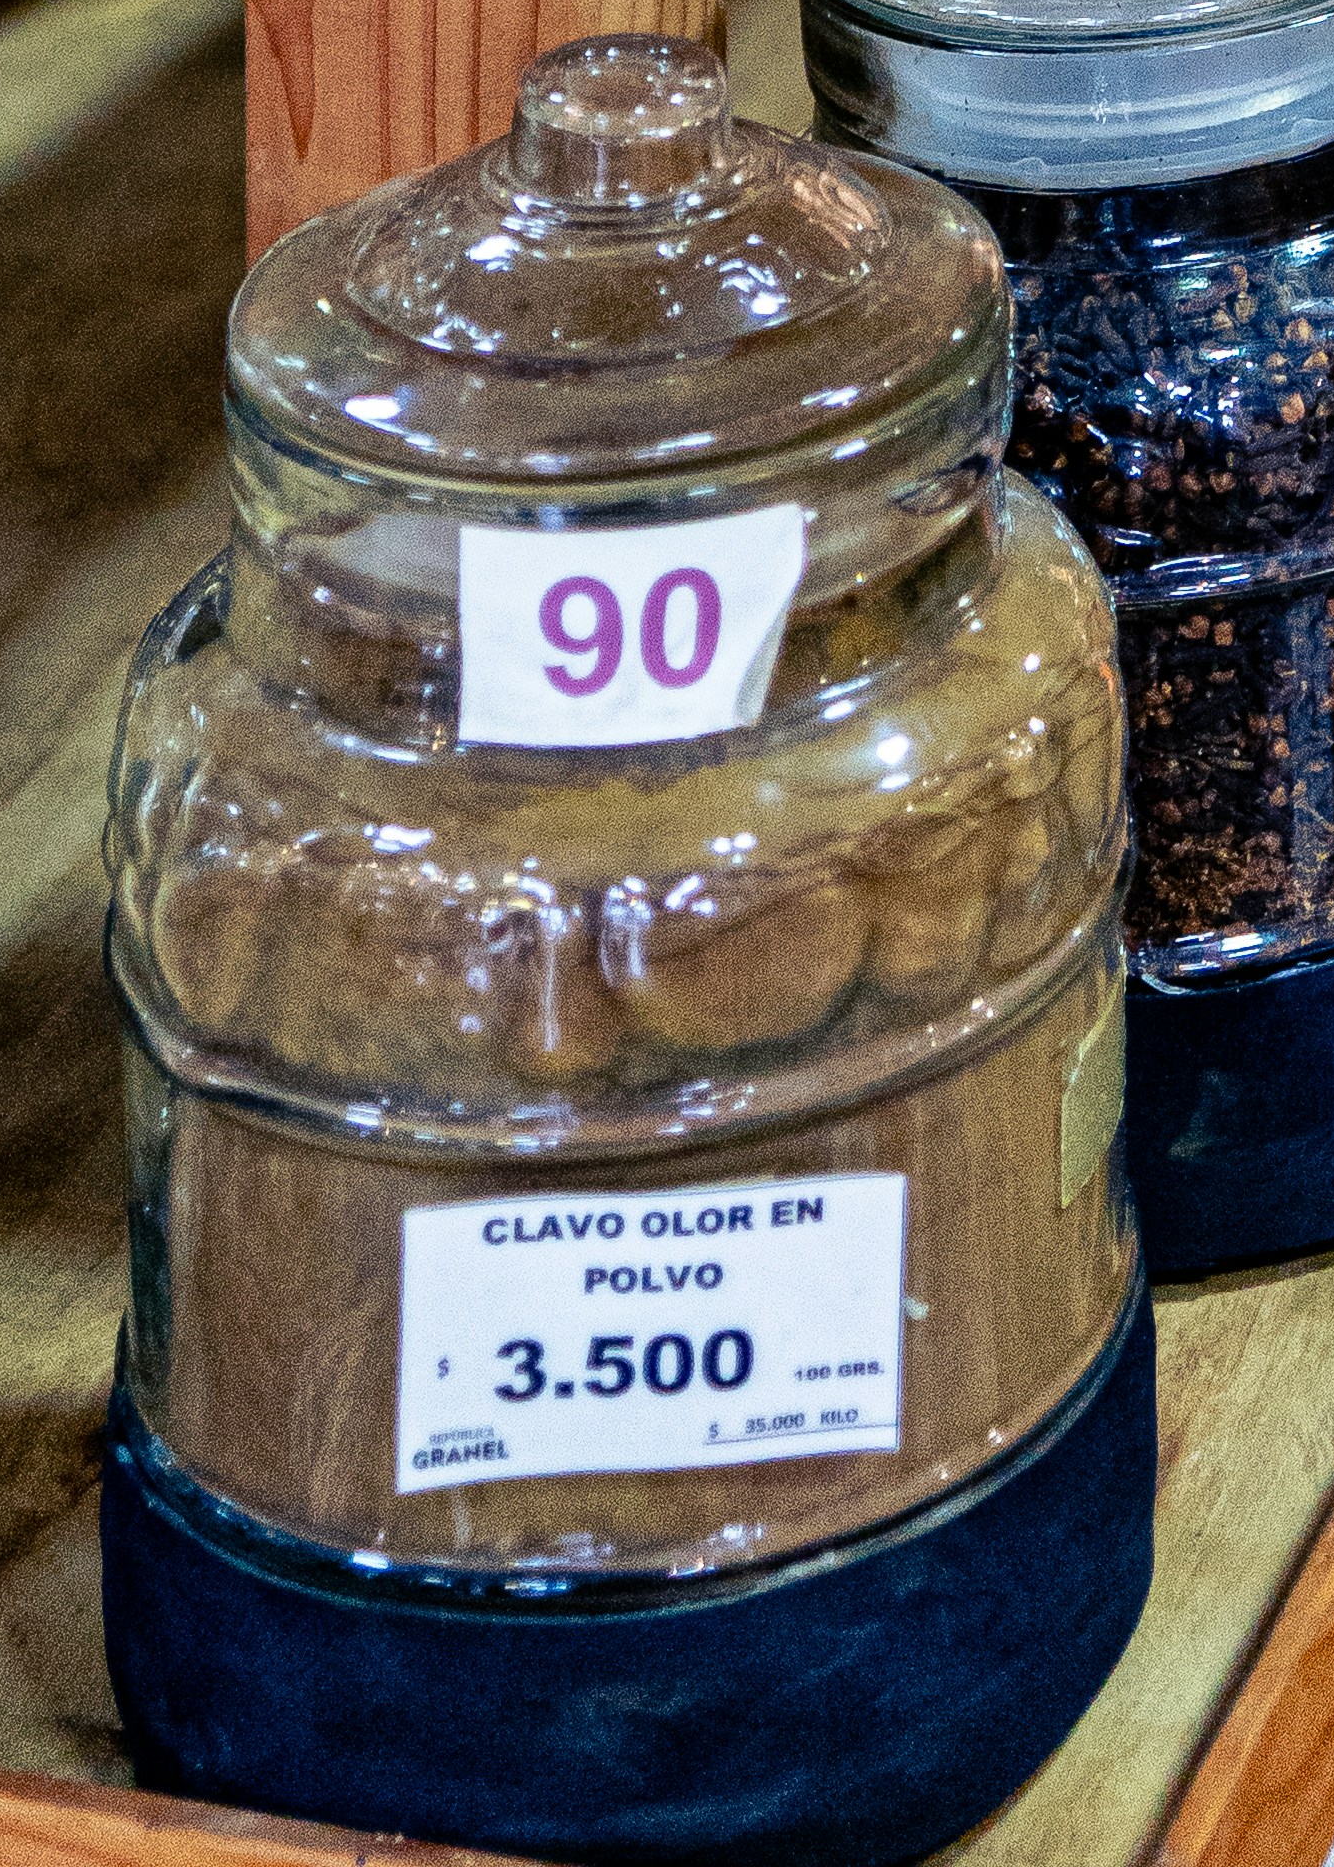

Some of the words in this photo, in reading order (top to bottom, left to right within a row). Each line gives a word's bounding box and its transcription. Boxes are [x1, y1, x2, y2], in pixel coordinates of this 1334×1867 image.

[539, 566, 723, 698] 90
[482, 1211, 626, 1246] CLAVO
[640, 1203, 755, 1239] OLOR
[769, 1195, 825, 1228] EN
[583, 1261, 725, 1295] POLVO
[437, 1357, 450, 1381] $
[493, 1328, 755, 1403] 3.500
[794, 1365, 832, 1382] 100
[745, 1411, 806, 1435] 35.000
[820, 1407, 860, 1426] KILO
[412, 1438, 509, 1469] GRANEL
